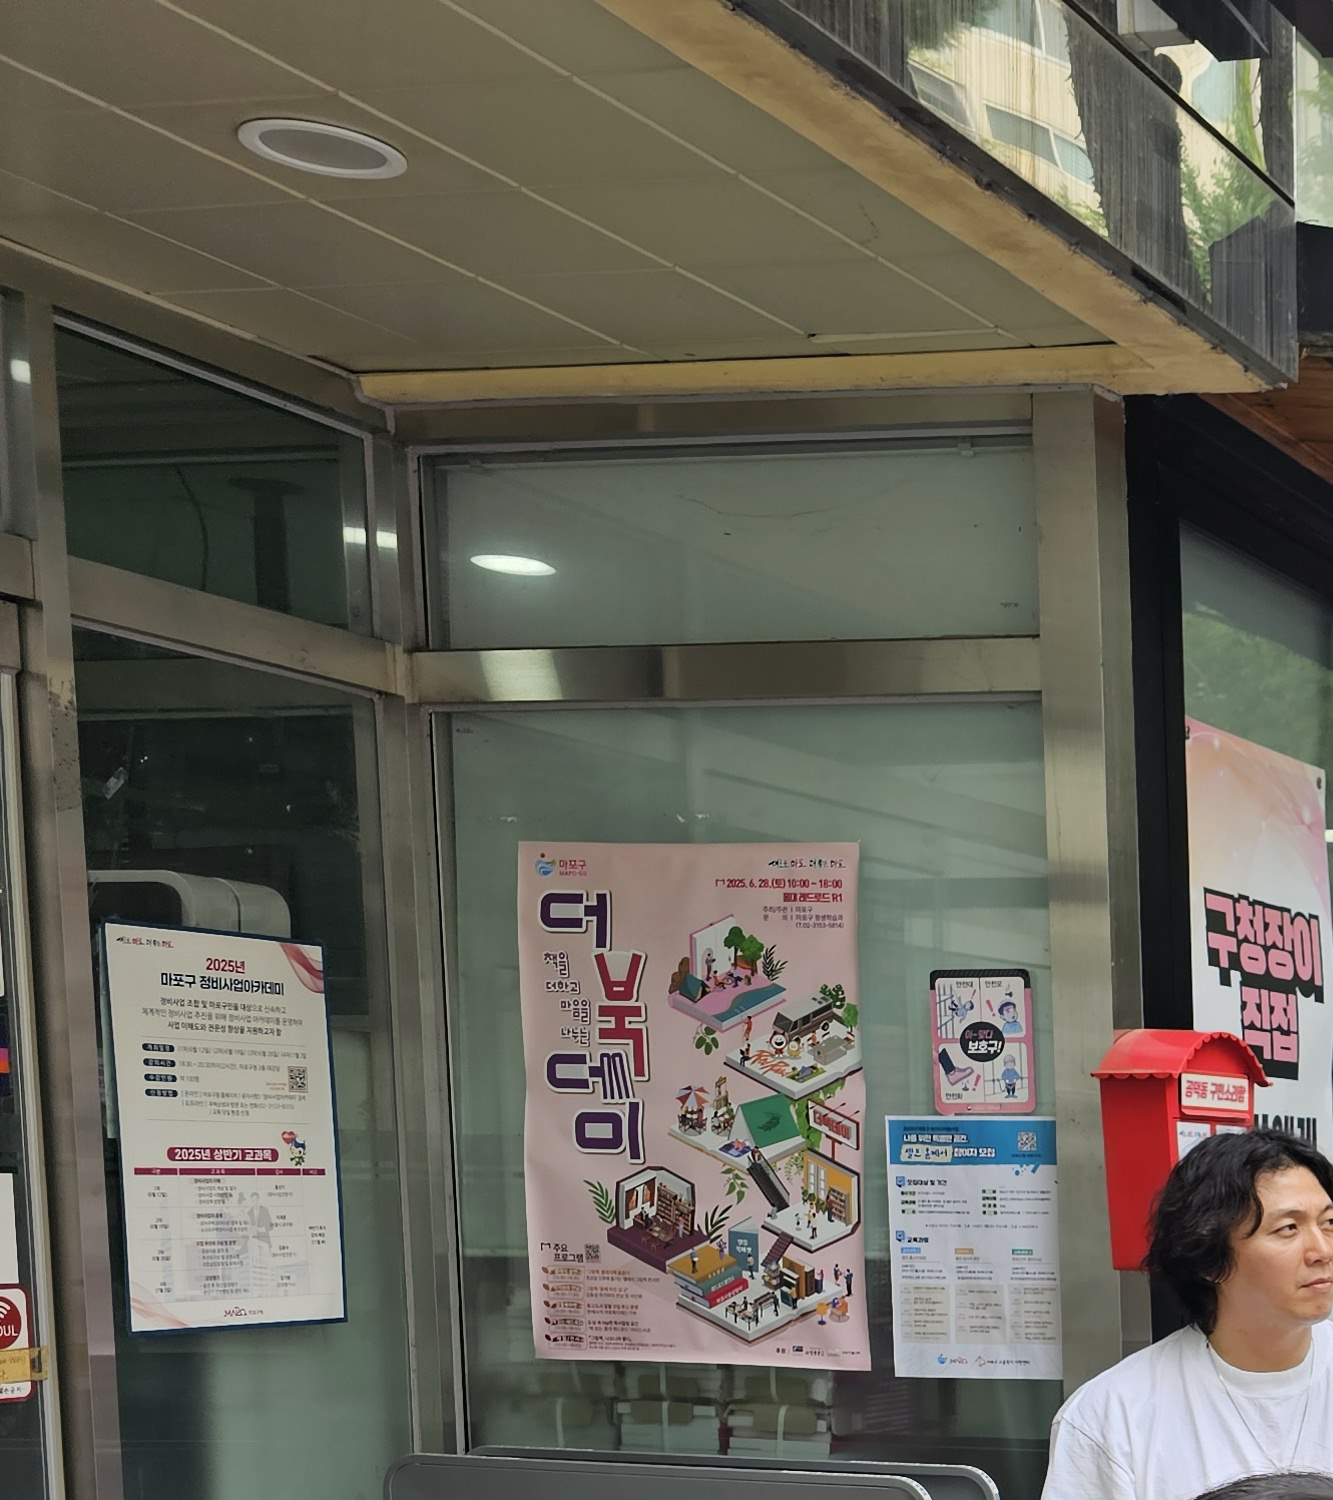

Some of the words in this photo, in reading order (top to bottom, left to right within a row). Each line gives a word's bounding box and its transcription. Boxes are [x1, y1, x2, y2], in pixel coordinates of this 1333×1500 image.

[558, 859, 587, 870] 마포구
[726, 879, 748, 889] 2025.
[749, 879, 757, 889] 6.
[787, 879, 810, 889] 10:00
[819, 879, 843, 889] 18:00
[832, 893, 843, 902] R1
[1205, 893, 1323, 987] 구청장이
[206, 958, 245, 974] 2025년
[544, 953, 569, 977] 책을
[160, 972, 197, 988] 마포구
[199, 976, 285, 996] 정비사업아카데미
[546, 981, 580, 994] 더하고
[560, 1000, 590, 1024] 마음을
[1241, 986, 1299, 1063] 직접
[561, 1028, 589, 1045] 나누는
[967, 1040, 1002, 1054] 보호구!
[1185, 1080, 1209, 1099] 공덕동
[1210, 1082, 1247, 1103] 구민소리함
[174, 1149, 211, 1161] 2025년
[213, 1149, 243, 1161] 상반기
[244, 1150, 273, 1161] 교과목
[553, 1243, 568, 1252] 주요
[554, 1253, 584, 1262] 프로그램
